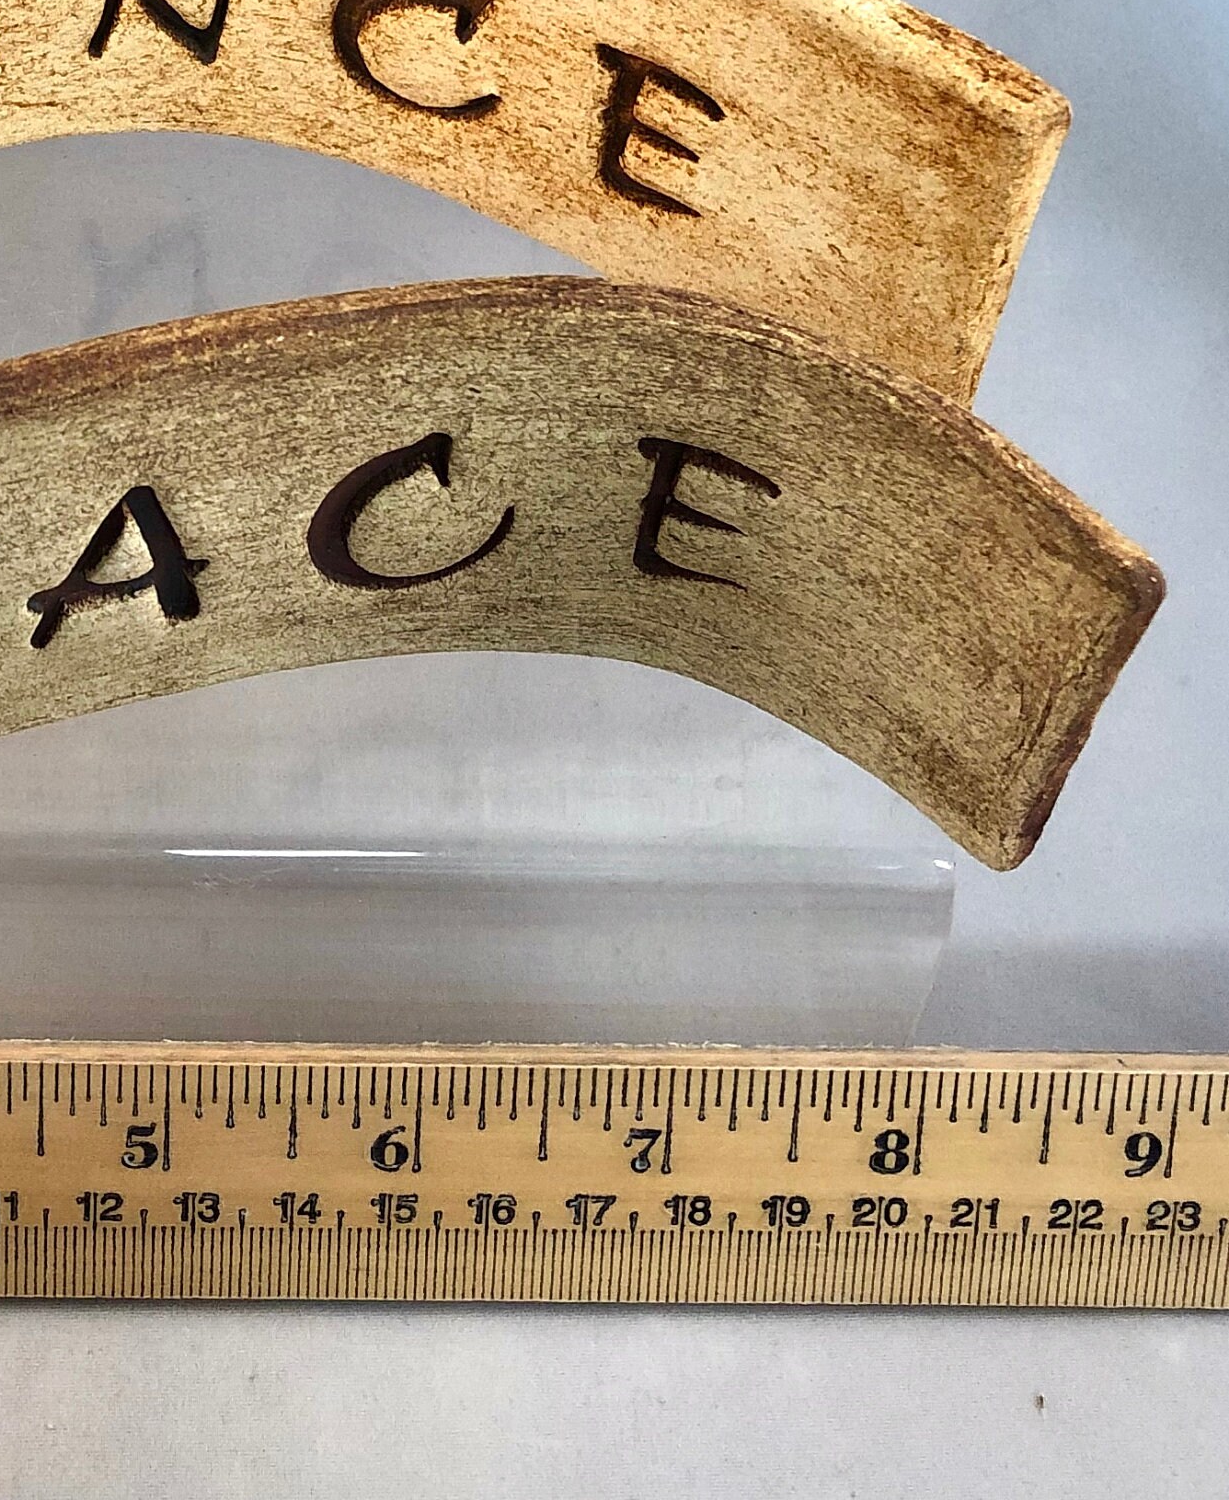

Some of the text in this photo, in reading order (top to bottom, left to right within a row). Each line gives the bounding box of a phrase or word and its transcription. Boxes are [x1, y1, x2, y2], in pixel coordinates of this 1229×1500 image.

[121, 1124, 158, 1169] 5
[371, 1126, 408, 1171] 6
[624, 1128, 662, 1172] 7
[870, 1129, 910, 1174] 8
[1125, 1132, 1162, 1177] 9
[77, 1194, 123, 1221] 12
[174, 1193, 220, 1221] 13
[273, 1195, 320, 1221] 14
[371, 1195, 417, 1222] 15
[469, 1195, 516, 1224] 16
[566, 1195, 616, 1224] 17
[665, 1195, 712, 1225] 18
[763, 1196, 810, 1225] 19
[852, 1198, 908, 1226] 20
[951, 1198, 999, 1228] 21
[1047, 1199, 1103, 1229] 22
[1146, 1201, 1202, 1230] 23
